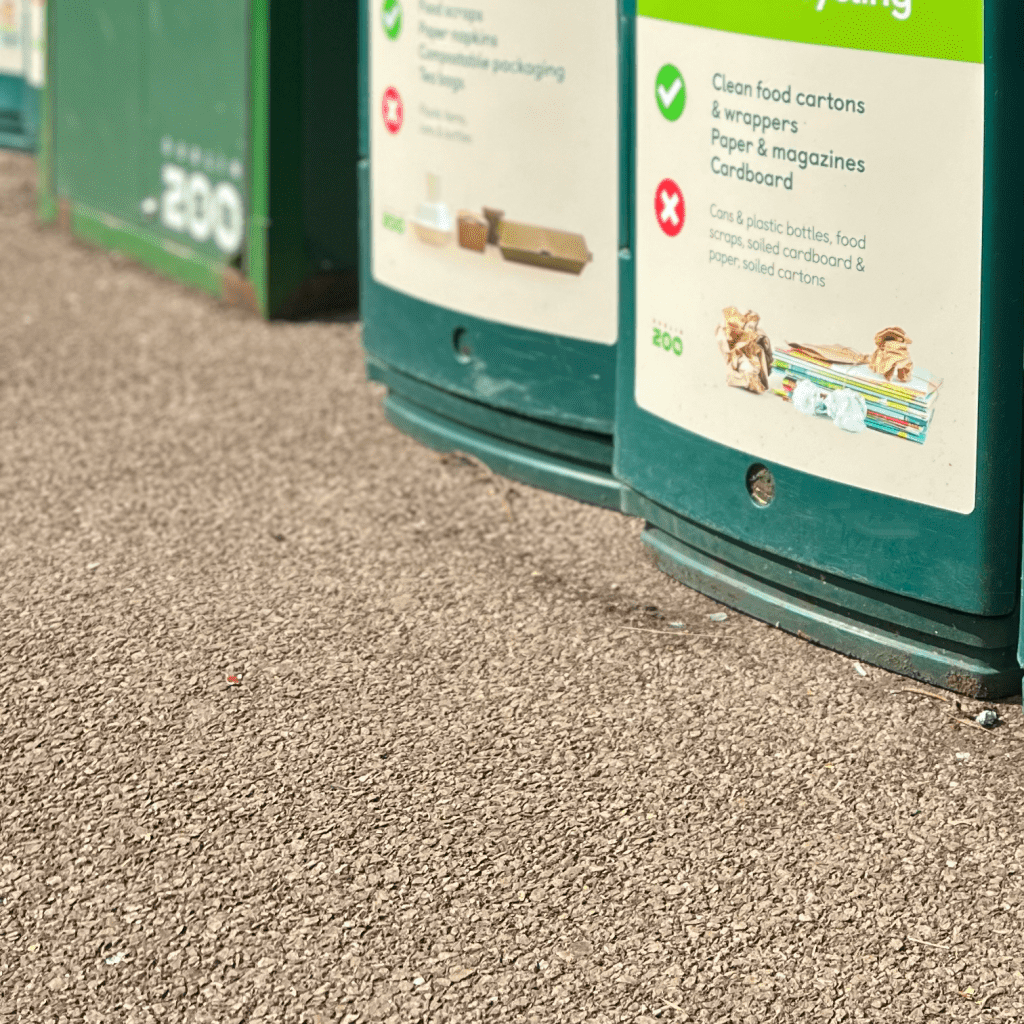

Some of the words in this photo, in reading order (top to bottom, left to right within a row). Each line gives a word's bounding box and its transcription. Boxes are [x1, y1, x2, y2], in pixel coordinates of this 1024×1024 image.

[492, 58, 566, 85] packaging
[712, 72, 752, 97] Clean
[756, 80, 791, 104] food
[796, 92, 865, 114] cartons
[711, 100, 721, 119] &
[724, 107, 798, 134] wrappers
[711, 127, 753, 155] Paper
[757, 137, 767, 157] &
[772, 149, 865, 173] magazines
[710, 156, 793, 190] Cardboard
[709, 203, 734, 223] Cans
[736, 210, 743, 225] &
[747, 213, 783, 234] plastic
[786, 221, 833, 245] bottles,
[836, 230, 866, 250] food
[709, 228, 745, 249] scraps,
[747, 238, 780, 255] soiled
[782, 247, 852, 269] cardboard
[855, 256, 865, 272] &
[709, 249, 740, 268] paper,
[742, 259, 774, 276] soiled
[777, 268, 826, 287] cartons
[652, 327, 683, 357] ZOO
